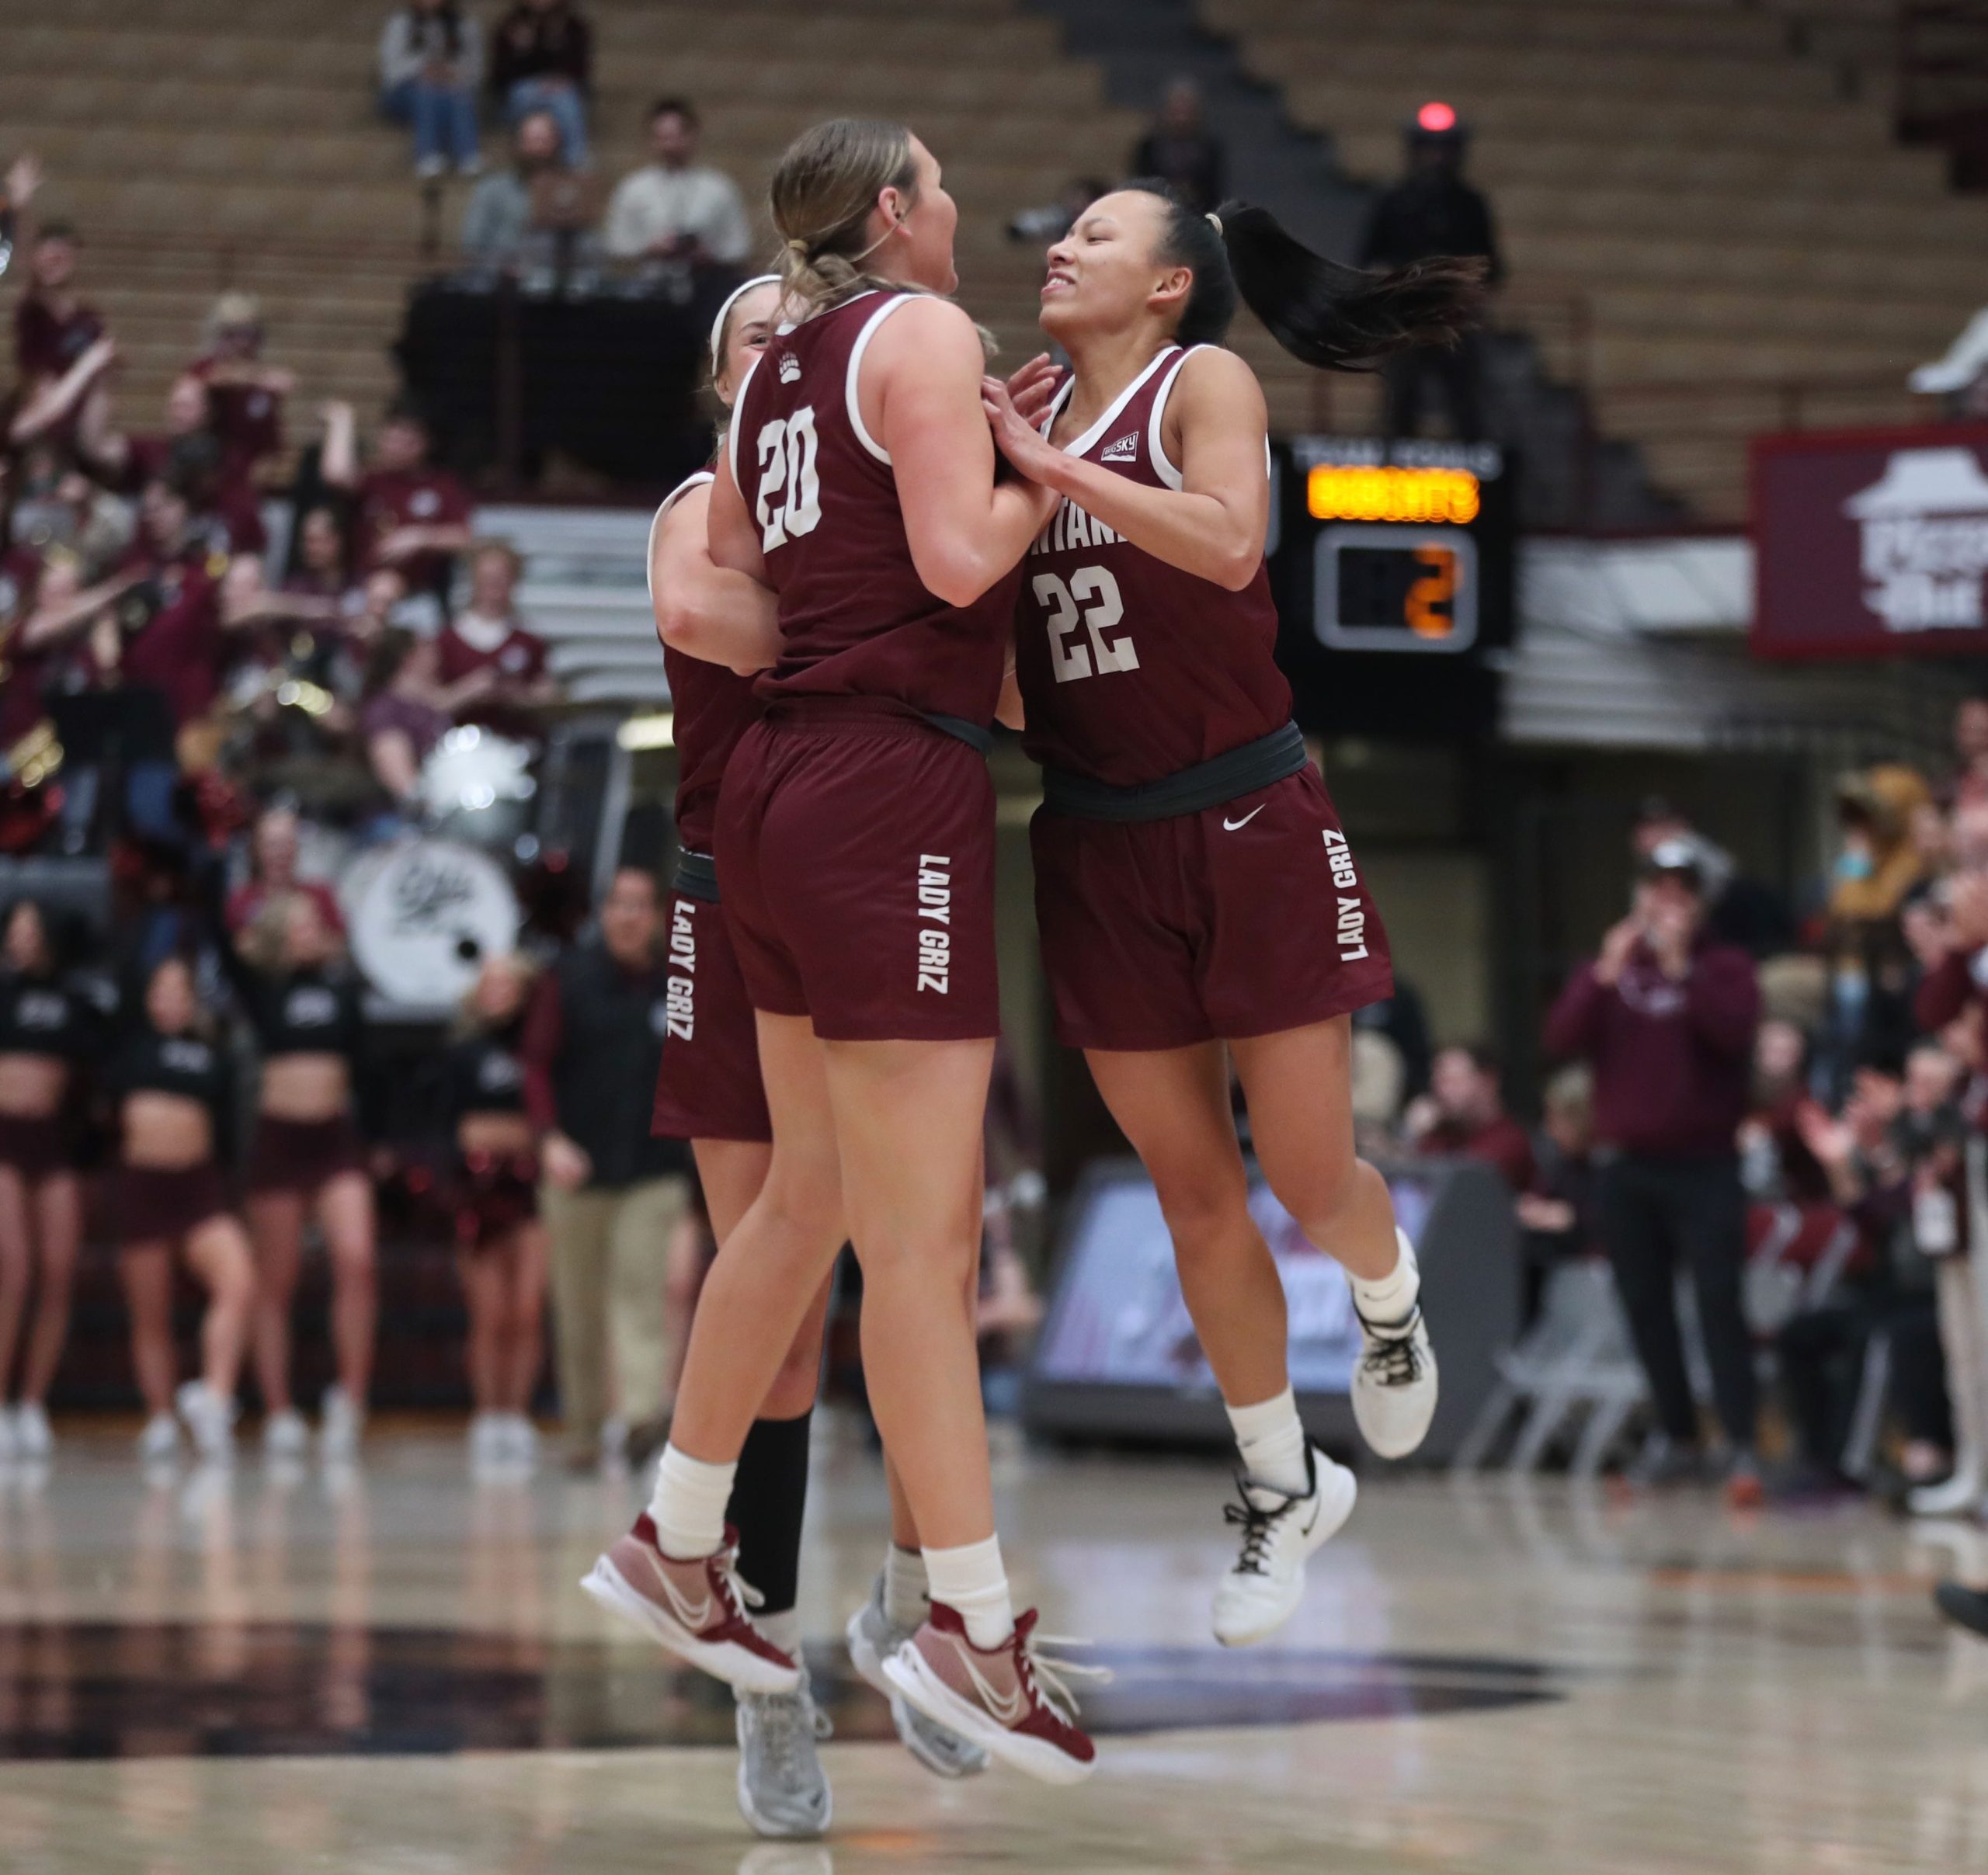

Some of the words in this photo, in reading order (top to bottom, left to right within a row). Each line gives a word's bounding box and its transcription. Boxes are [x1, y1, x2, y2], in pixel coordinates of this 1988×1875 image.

[756, 405, 822, 555] 20
[1032, 565, 1140, 683] 22
[1404, 542, 1465, 640] 2
[918, 854, 951, 925] LADY
[1322, 827, 1357, 889] GRIZ
[669, 899, 697, 974] LADY
[917, 929, 951, 995] GRIZ
[1336, 897, 1369, 961] LADY
[666, 975, 694, 1042] GRIZ
